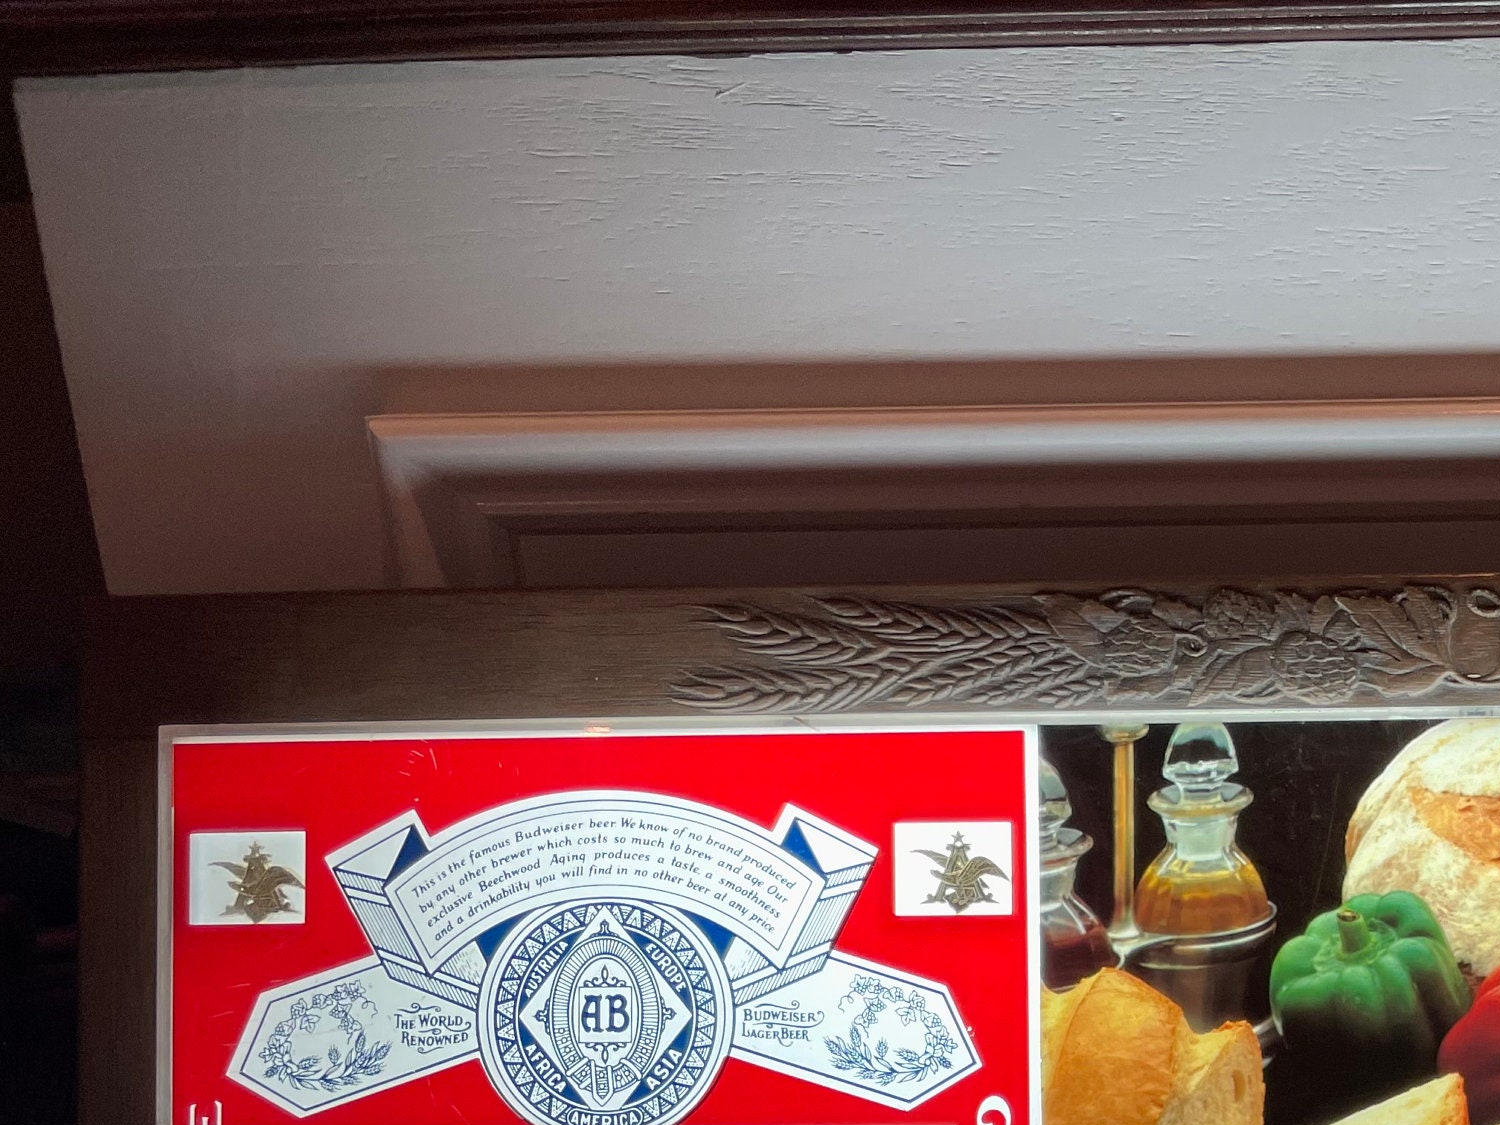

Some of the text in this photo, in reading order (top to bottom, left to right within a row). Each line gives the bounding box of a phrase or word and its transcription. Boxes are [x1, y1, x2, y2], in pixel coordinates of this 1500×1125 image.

[411, 880, 436, 898] This
[437, 870, 447, 881] is
[448, 857, 466, 874] the
[468, 838, 511, 865] famous
[515, 820, 584, 843] Budweiser
[620, 817, 636, 829] We
[638, 820, 669, 832] know
[673, 827, 688, 838] of
[688, 831, 703, 841] no
[705, 835, 744, 857] brand
[741, 854, 797, 890] produced
[419, 899, 434, 914] by
[436, 885, 456, 903] any
[459, 865, 487, 887] other
[491, 847, 532, 868] brewer
[537, 836, 572, 852] which
[577, 834, 608, 845] costs
[614, 836, 626, 844] so
[631, 836, 664, 848] much
[670, 840, 681, 852] to
[684, 841, 714, 861] brew
[717, 859, 743, 875] and
[767, 885, 789, 904] Our
[427, 891, 473, 927] exclusive
[478, 859, 541, 892] Beechwood
[549, 853, 586, 866] Aging
[594, 849, 650, 862] produces
[657, 856, 665, 865] a
[705, 870, 714, 880] a
[718, 877, 782, 919] smoothness
[434, 923, 454, 941] and
[456, 915, 465, 925] a
[467, 880, 531, 918] drinkability
[535, 872, 556, 887] you
[561, 865, 584, 878] will
[588, 864, 612, 879] find
[616, 866, 628, 875] in
[634, 868, 648, 877] no
[652, 870, 684, 884] other
[686, 878, 711, 895] beer
[714, 890, 726, 902] at
[728, 899, 748, 916] any
[525, 940, 569, 998] AUSTRALIA
[645, 942, 686, 993] EUROPE
[394, 1013, 471, 1032] THE WORLD
[581, 994, 631, 1033] AB
[744, 1009, 819, 1023] BUDWEISER
[401, 1031, 469, 1047] RENOWNED
[524, 1043, 568, 1093] AFRICA
[648, 1049, 683, 1090] ASIA
